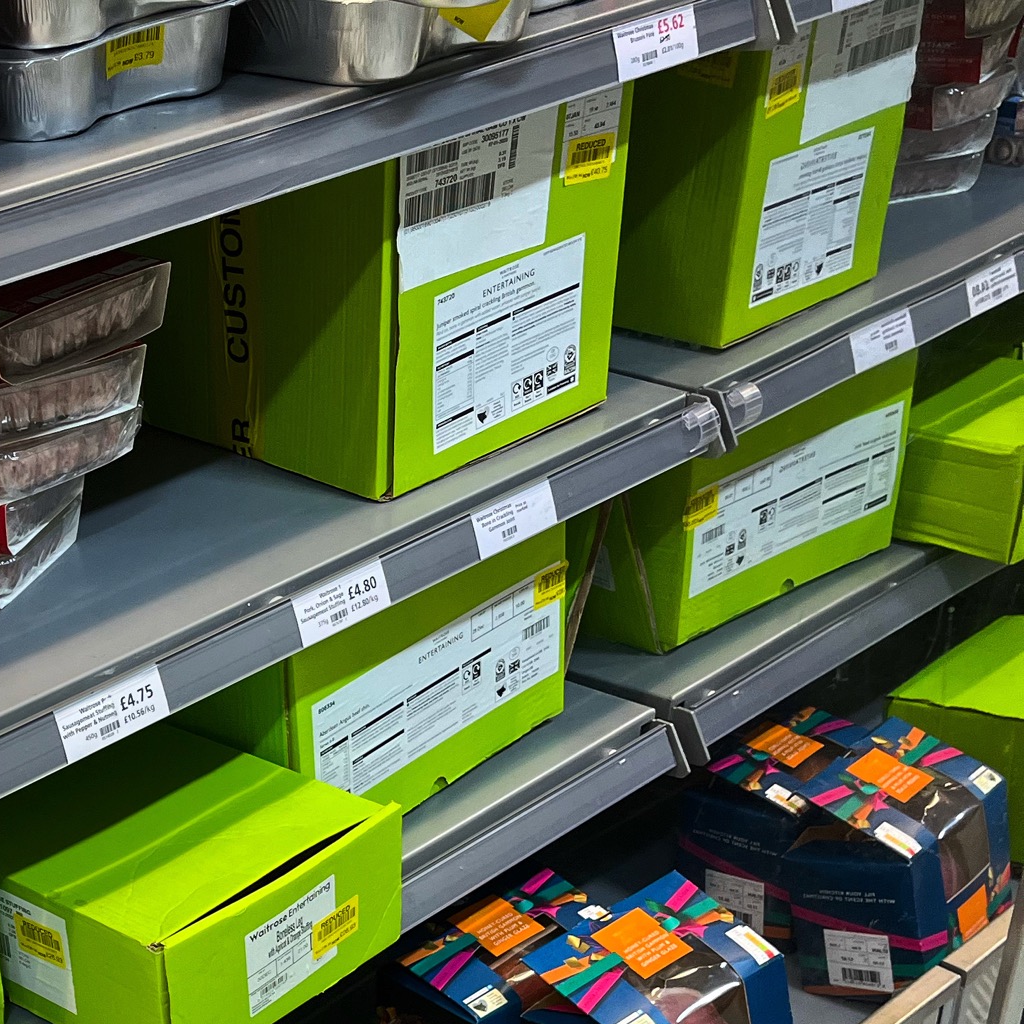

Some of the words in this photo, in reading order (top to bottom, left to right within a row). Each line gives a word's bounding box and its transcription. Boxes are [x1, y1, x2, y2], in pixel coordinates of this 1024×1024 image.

[658, 14, 684, 34] £5.62
[576, 138, 606, 151] REDUCED
[434, 174, 458, 188] 743720
[482, 268, 536, 298] ENTERTAINING
[493, 503, 512, 514] Christmas
[496, 510, 514, 521] Crackling
[488, 522, 505, 532] Gammon
[348, 576, 376, 600] £4.80
[316, 599, 329, 608] Onion
[334, 592, 344, 600] Sage
[351, 595, 379, 612] £12.80/kg
[300, 608, 328, 624] Sausagemeat
[329, 599, 346, 610] Stuffing
[418, 632, 464, 664] ENTERTAINING
[79, 700, 101, 714] Waitrose
[120, 684, 153, 711] £4.75
[62, 713, 95, 731] Sausagemeat
[96, 703, 115, 715] Stuffing
[124, 704, 155, 724] £10.56/kg
[62, 731, 75, 740] with
[75, 722, 93, 734] Pepper
[98, 710, 118, 723] Nutmeg
[249, 914, 288, 942] Waitrose
[288, 881, 331, 918] Entertaining
[320, 905, 350, 930] REDUCED
[276, 922, 296, 942] Boneless
